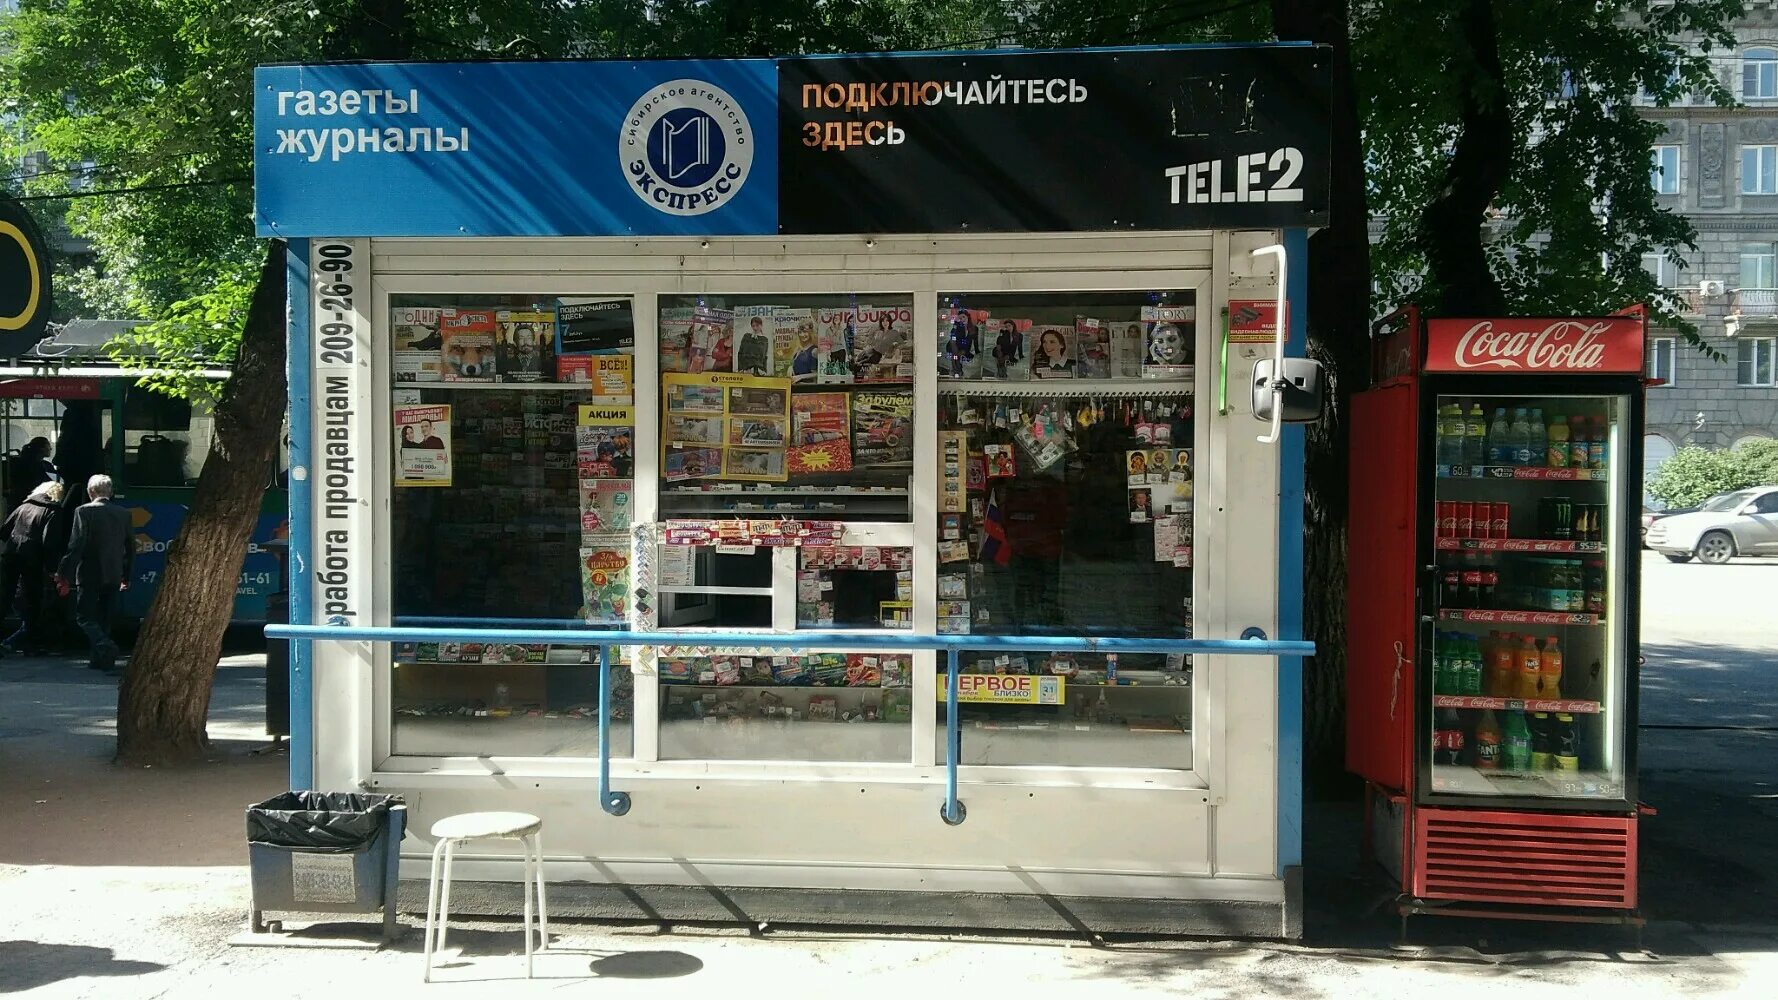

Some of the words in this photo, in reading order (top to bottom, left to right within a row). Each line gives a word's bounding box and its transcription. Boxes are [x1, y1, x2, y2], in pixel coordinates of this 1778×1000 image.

[277, 88, 418, 116] газеты
[802, 75, 1088, 112] ПОДКЛЮЧАЙТЕСЬ
[626, 86, 685, 146] сибирское
[690, 87, 745, 145] агентство
[276, 127, 468, 162] журналы
[802, 121, 906, 150] ЗДЕСЬ
[629, 158, 742, 210] ЭКСПРЕСС
[1165, 147, 1304, 204] TELE2
[318, 244, 354, 365] 209-26-90
[560, 303, 621, 314] ПОДКЛЮЧАЙТЕСЬ
[560, 313, 584, 321] ЗДЕСЬ
[588, 410, 627, 420] АКЦИЯ
[325, 376, 358, 520] продавцам
[140, 571, 157, 584] +7
[317, 530, 358, 616] работа
[945, 676, 1031, 690] ЕРВОЕ
